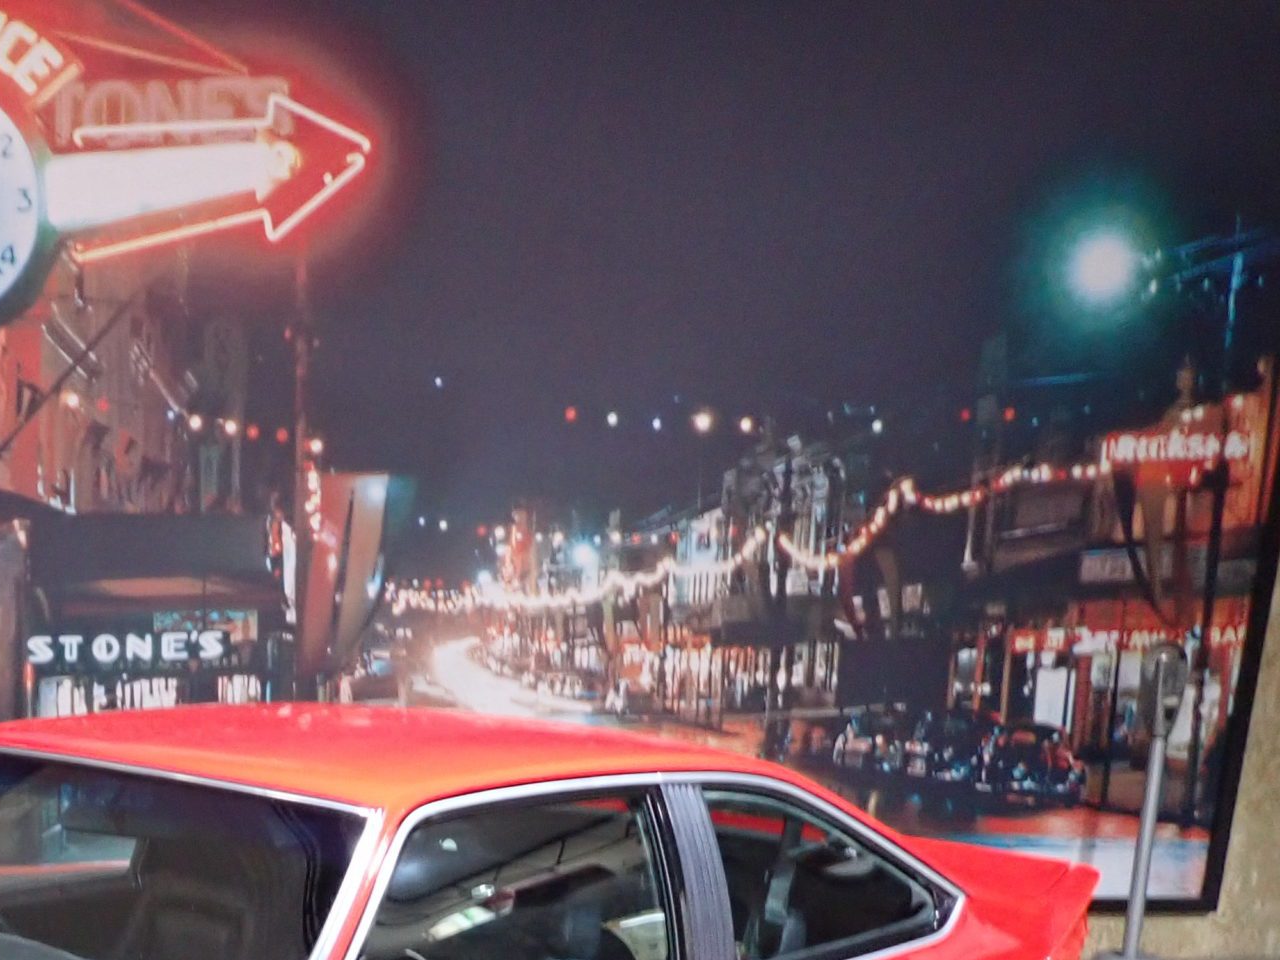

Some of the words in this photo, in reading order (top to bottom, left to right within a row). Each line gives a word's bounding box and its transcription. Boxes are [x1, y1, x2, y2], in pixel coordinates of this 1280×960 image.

[1, 133, 13, 160] 2
[16, 187, 33, 213] 3
[1, 244, 16, 266] 4
[27, 629, 225, 665] STONE'S
